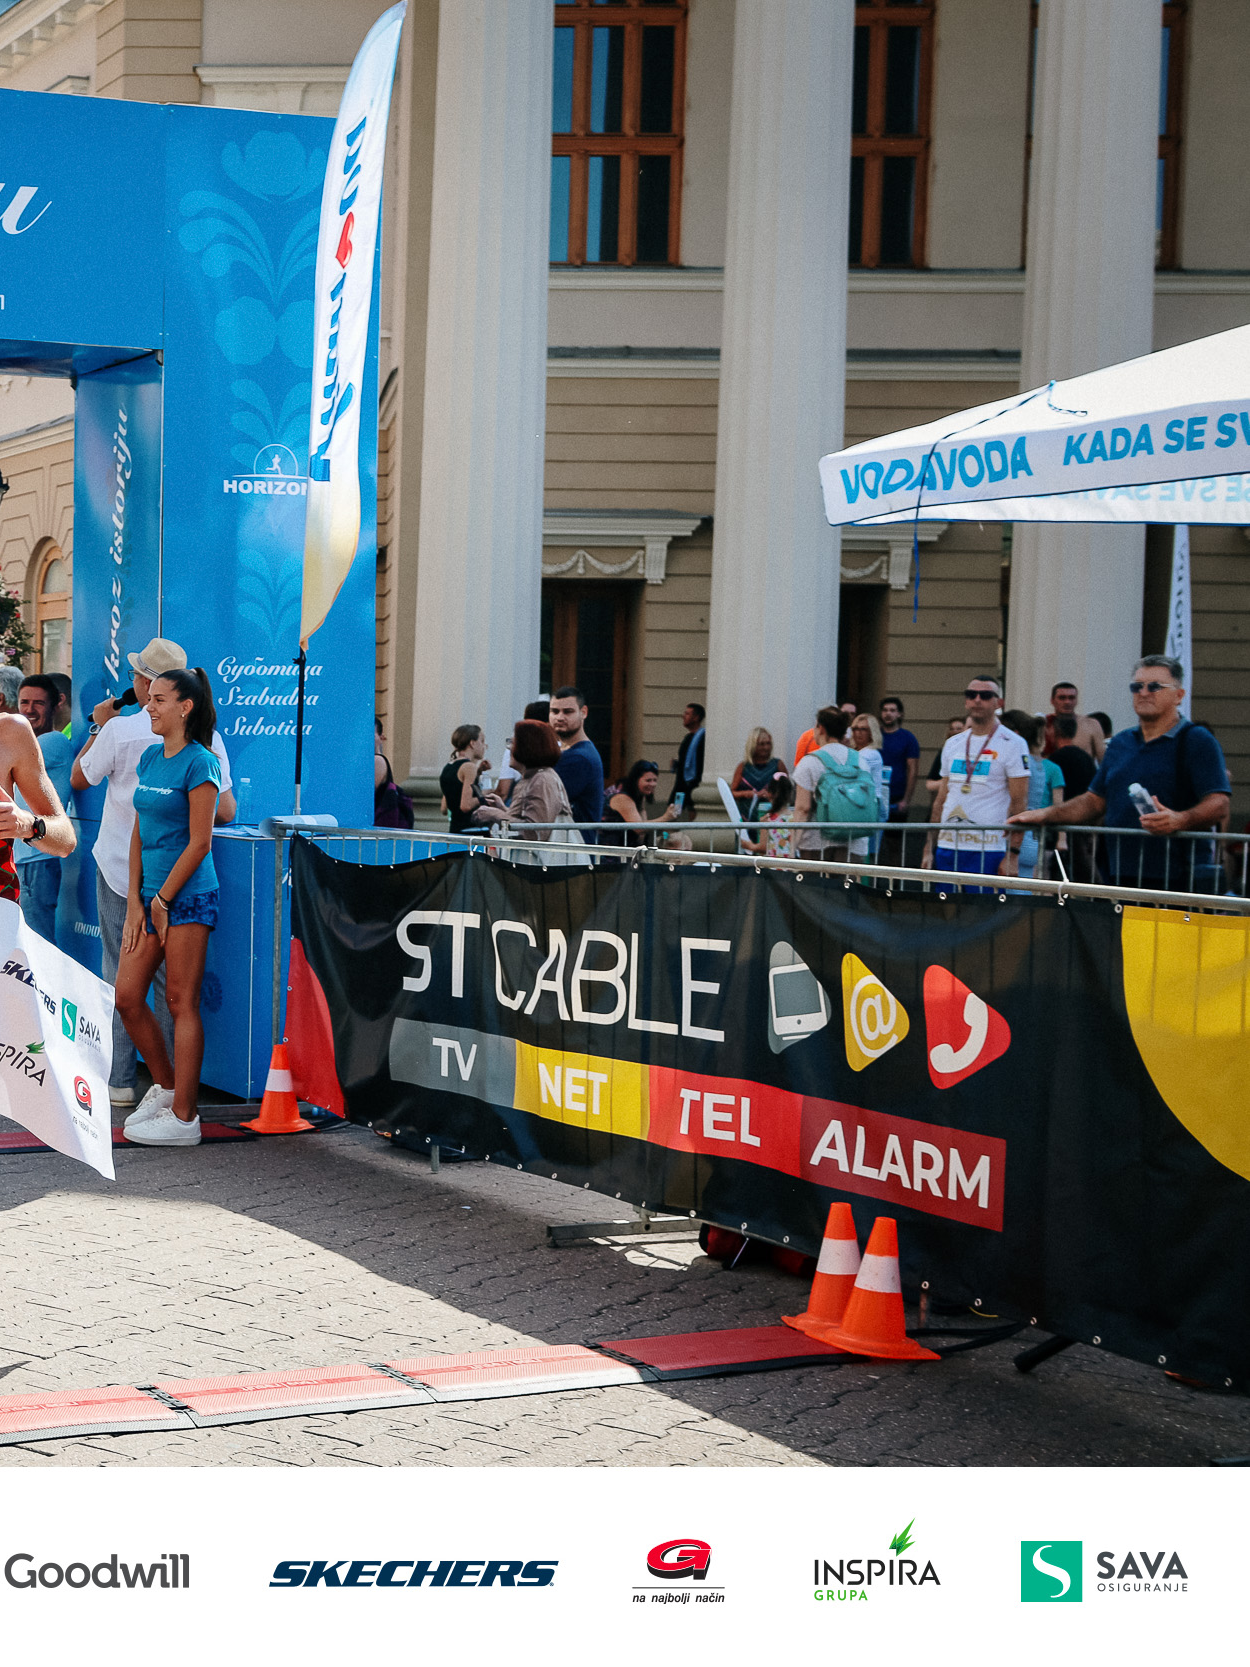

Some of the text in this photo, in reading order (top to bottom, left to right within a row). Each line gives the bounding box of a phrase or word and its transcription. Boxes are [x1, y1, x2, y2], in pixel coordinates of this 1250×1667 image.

[108, 402, 133, 566] istoriju
[840, 435, 1033, 504] VODAVODA
[1063, 423, 1154, 466] KADA
[1163, 416, 1208, 454] SE
[103, 573, 122, 683] kroz
[218, 685, 319, 706] Szabada
[79, 1016, 102, 1045] SAVA
[396, 910, 731, 1042] ST CABLE
[431, 1037, 991, 1209] TV NET TEL ALARM
